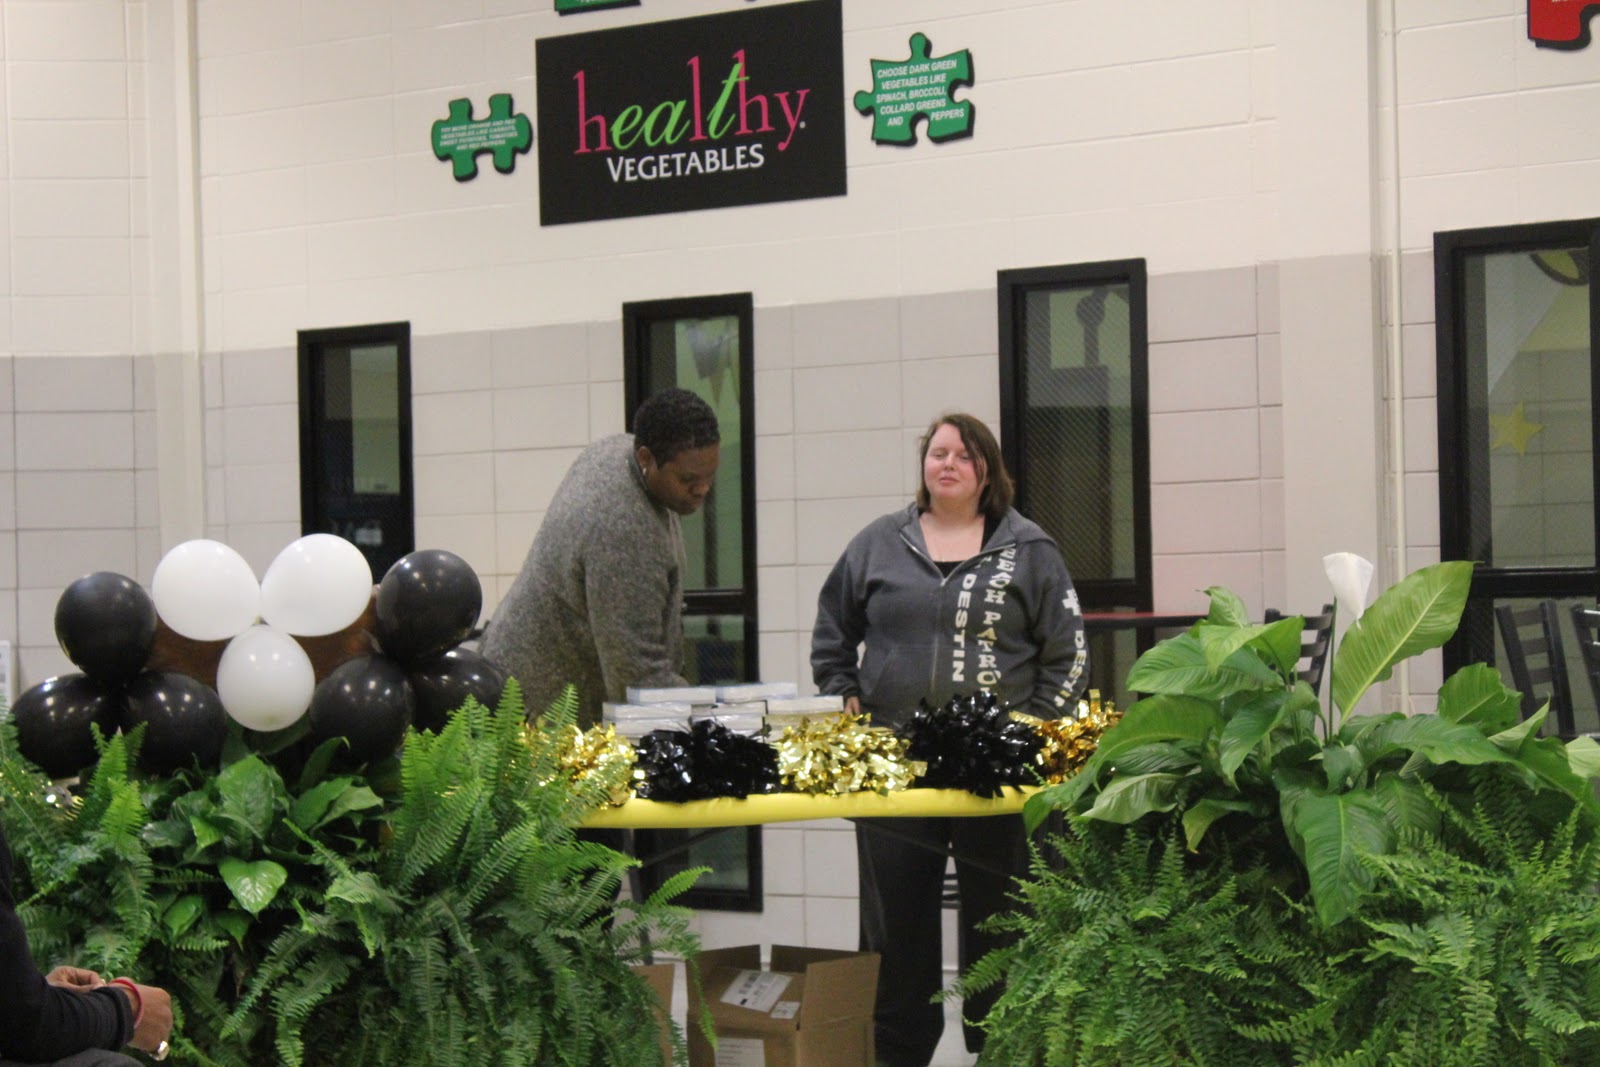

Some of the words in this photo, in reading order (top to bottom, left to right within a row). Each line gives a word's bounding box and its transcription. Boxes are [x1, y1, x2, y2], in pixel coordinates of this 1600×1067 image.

[877, 66, 908, 78] CHOOSE
[909, 63, 930, 74] DARK
[931, 59, 958, 71] GREEN
[881, 75, 929, 90] VEGETABLES
[929, 73, 947, 84] LIKE
[572, 48, 811, 154] healthy
[880, 102, 915, 115] COLLARD
[915, 98, 947, 111] GREENS
[887, 116, 903, 127] AND
[930, 108, 965, 121] PEPPERS
[607, 143, 765, 183] VEGETABLES
[952, 573, 977, 682] DESTIN
